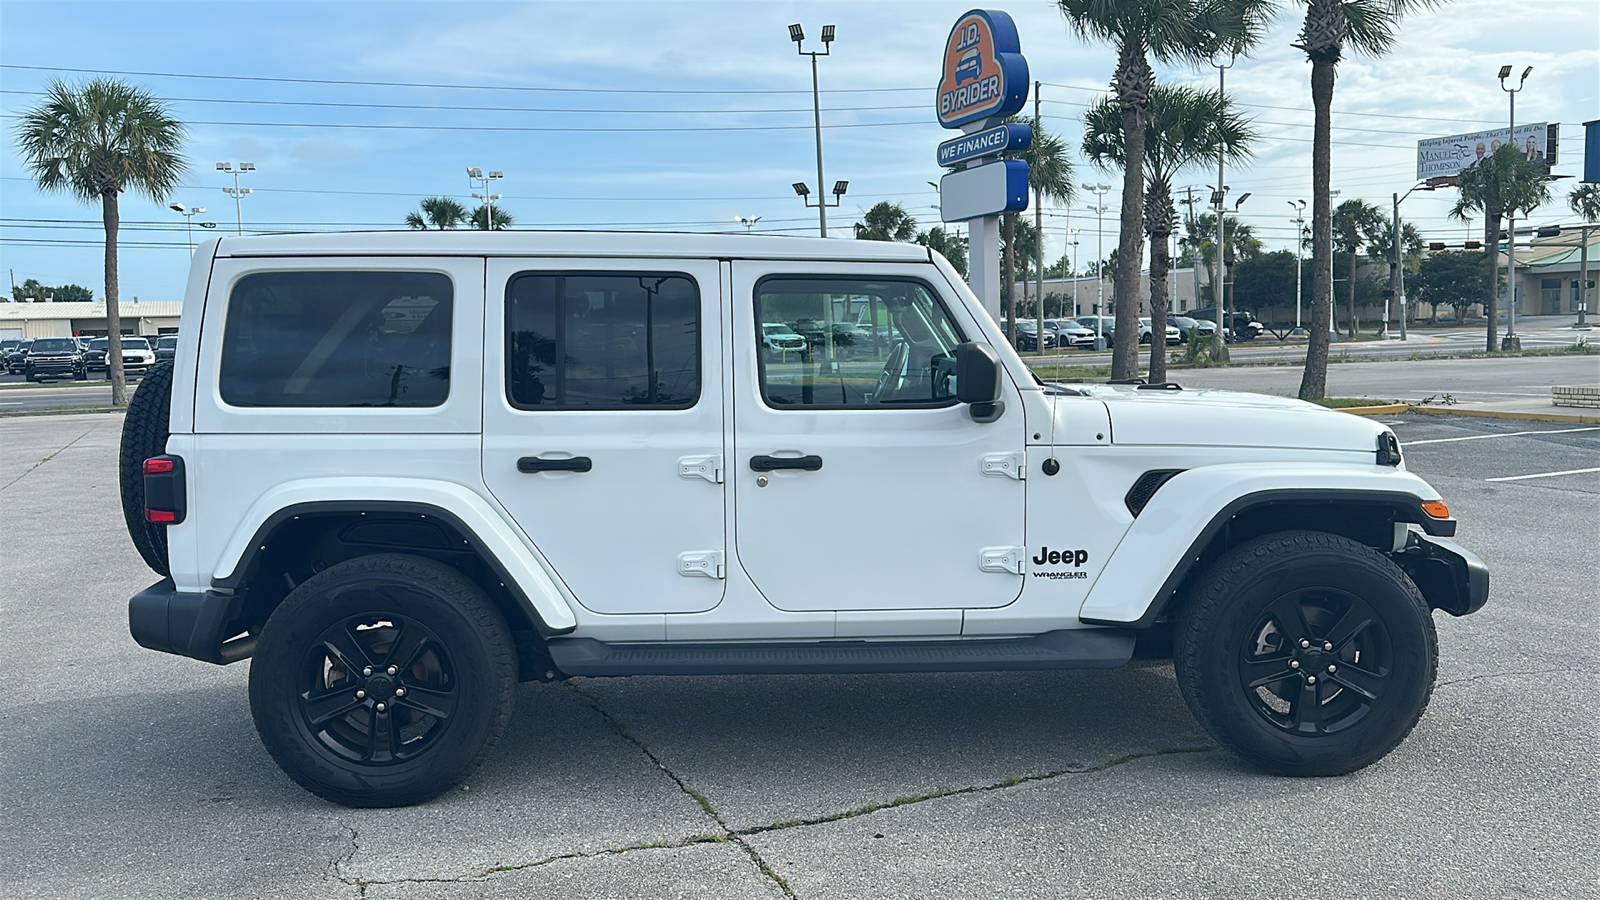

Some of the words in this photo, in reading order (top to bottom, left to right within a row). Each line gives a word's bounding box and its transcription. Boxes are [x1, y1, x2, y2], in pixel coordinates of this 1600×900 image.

[957, 22, 980, 50] J.D.
[941, 75, 999, 115] BYRIDER
[941, 146, 955, 160] WE
[956, 131, 1005, 156] FINANCE!
[1420, 140, 1441, 148] Helping
[1443, 137, 1462, 145] Injured
[1420, 150, 1451, 161] MANUEL
[1420, 161, 1460, 172] THOMPSON
[1033, 547, 1088, 567] Jeep
